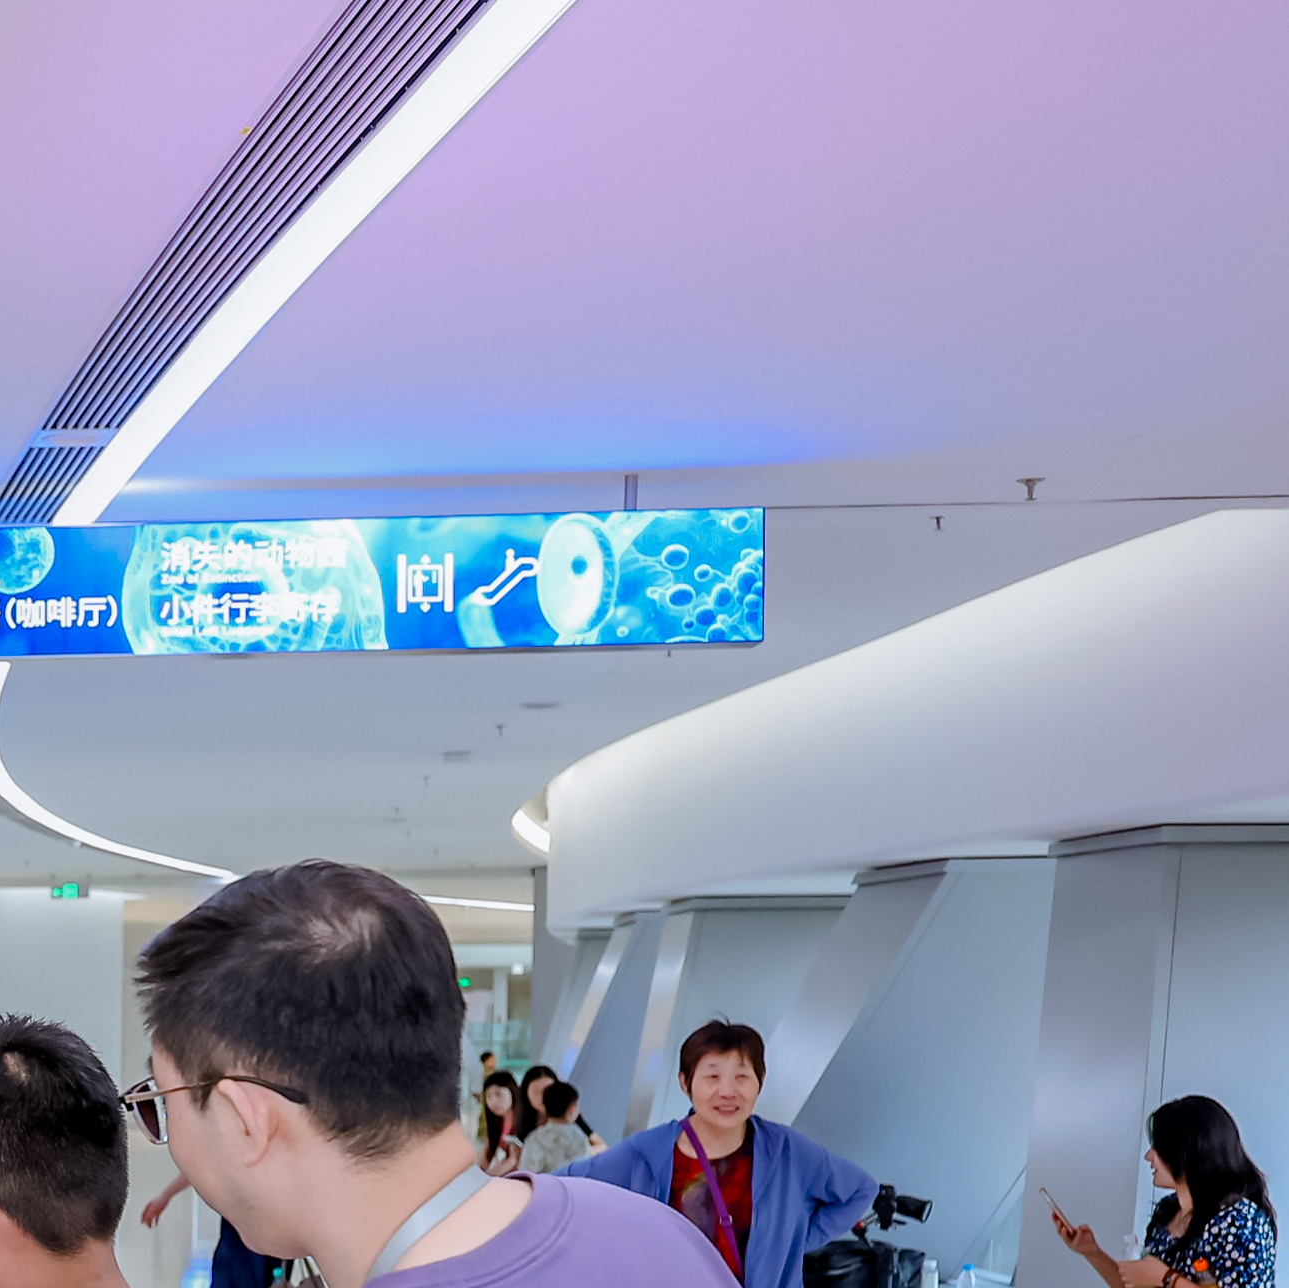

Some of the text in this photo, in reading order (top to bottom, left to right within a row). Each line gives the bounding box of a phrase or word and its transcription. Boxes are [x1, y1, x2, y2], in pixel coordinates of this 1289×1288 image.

[161, 538, 348, 571] 消失的动物园
[161, 592, 340, 625] 小件行李寄存
